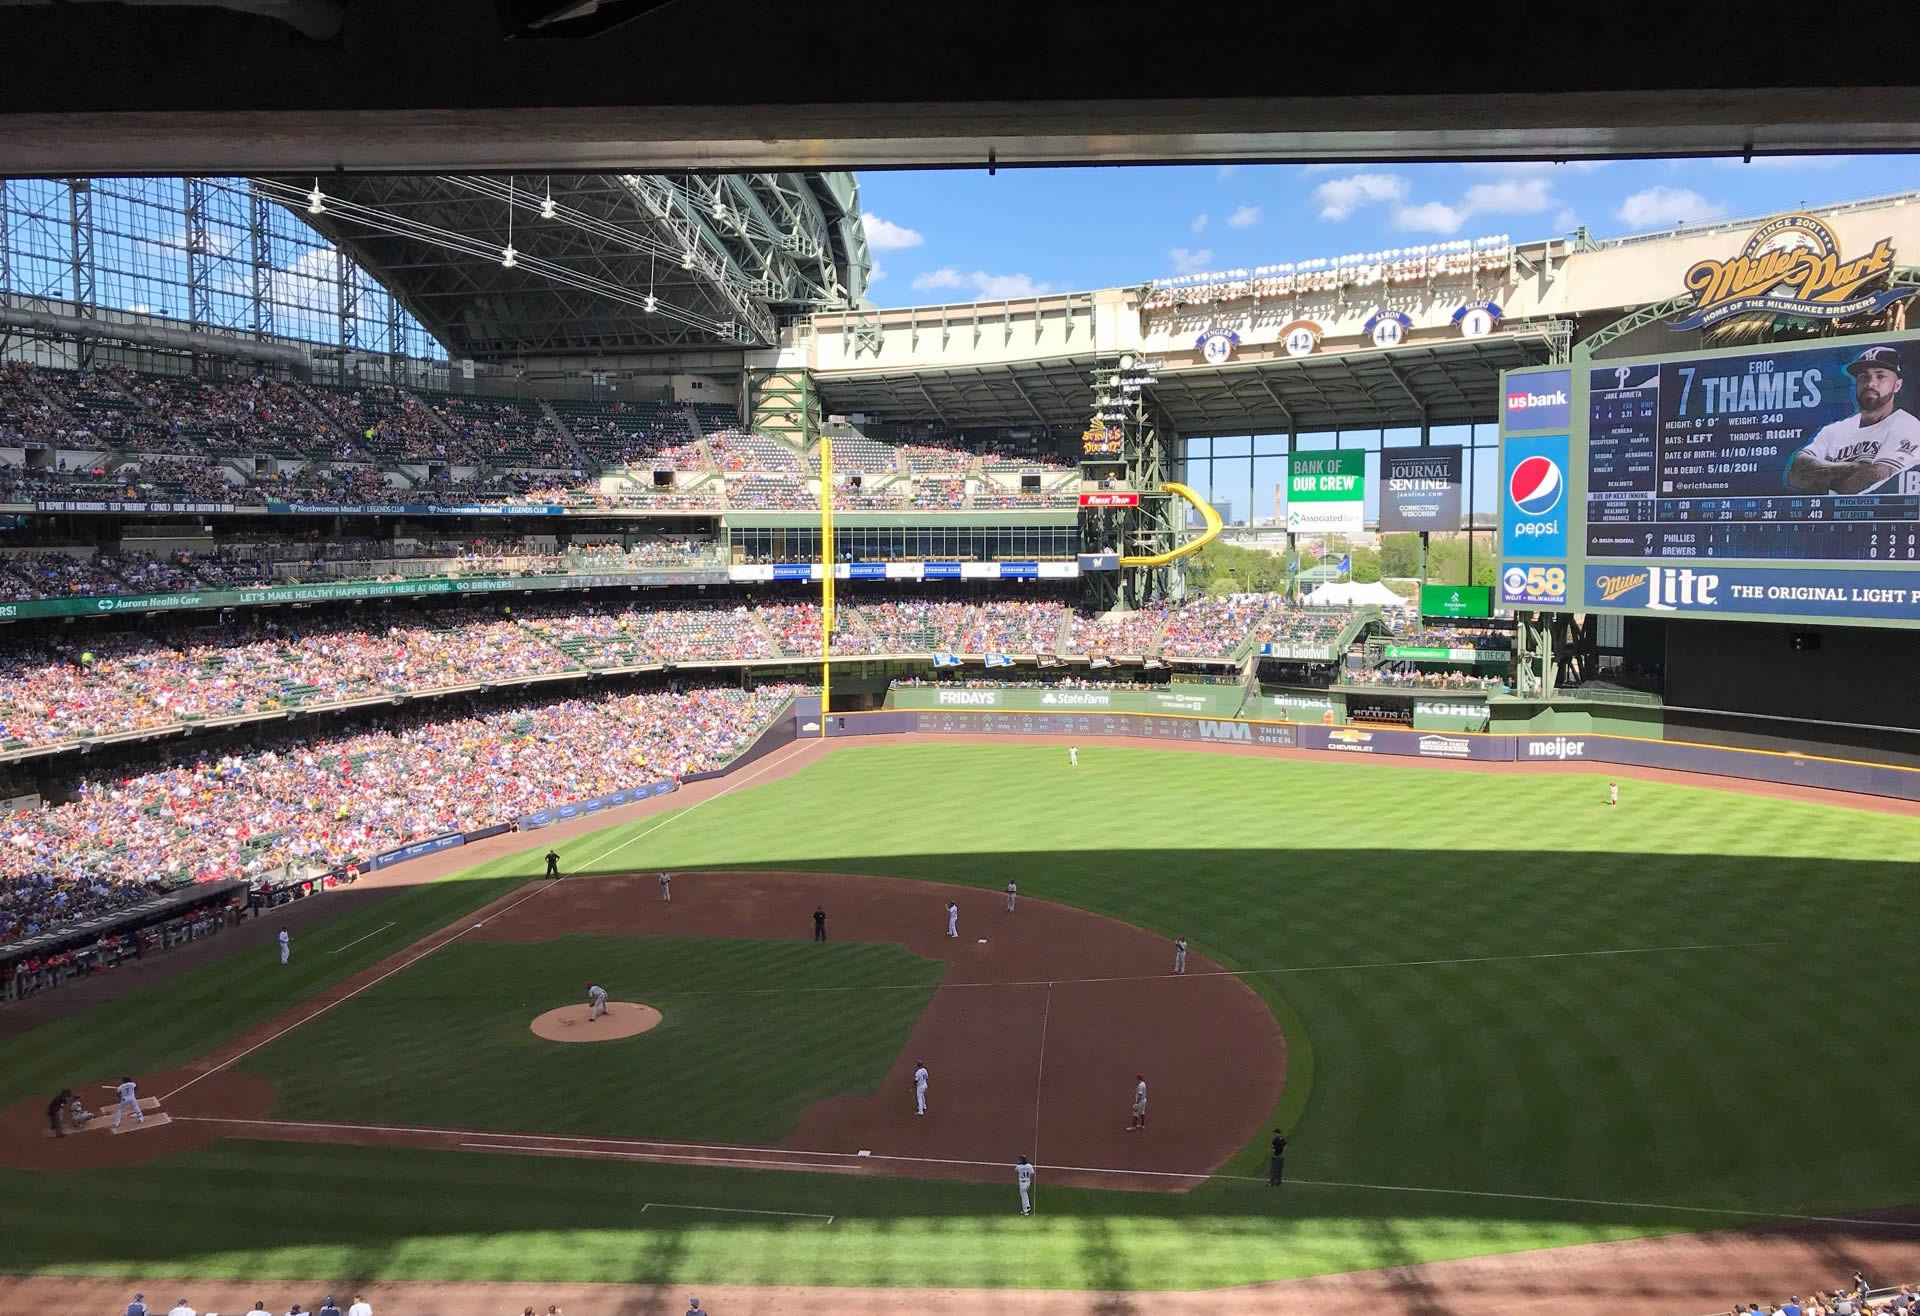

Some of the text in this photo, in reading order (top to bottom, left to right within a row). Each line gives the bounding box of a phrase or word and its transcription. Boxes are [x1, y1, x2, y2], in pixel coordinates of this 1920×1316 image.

[1757, 218, 1821, 241] SINCE 2001
[1688, 237, 1893, 307] Miller Park
[1465, 300, 1490, 310] SELIG
[1703, 296, 1876, 323] HOME OF THE MILWAUKEE BREWERS
[1374, 310, 1401, 322] AARON
[1472, 316, 1482, 335] 1
[1203, 330, 1234, 340] FINGERS
[1376, 324, 1398, 342] 44
[1289, 333, 1310, 349] 42
[1207, 341, 1227, 358] 34
[1749, 360, 1774, 374] ERIC
[1604, 391, 1642, 400] JAKE ARRIETA
[1678, 367, 1696, 416] 7
[1702, 368, 1822, 414] THAMES
[1665, 420, 1693, 429] HEIGHT:
[1728, 416, 1759, 426] WEIGHT:
[1761, 413, 1784, 424] 240
[1665, 428, 1803, 445] BATS: LEFT THROWS: RIGHT
[1664, 446, 1778, 460] DATE OF BIRTH: 11/10/1986
[1294, 460, 1343, 475] BANK OF
[1391, 464, 1452, 480] JOURNAL
[1664, 463, 1758, 475] MLB DEBUT: 5/18/2011
[1293, 475, 1317, 491] OUR
[1389, 478, 1452, 491] SENTINEL
[1676, 481, 1729, 491] @ericthames
[46, 501, 65, 511] REPORT
[110, 502, 122, 512] TEXT
[297, 503, 405, 513] Northwestern Mutual LEGENDS CLUB
[436, 505, 548, 514] Northwestern Mutual LEGENDS CLUB
[1721, 501, 1731, 509] 24
[1767, 500, 1772, 508] 5
[1810, 499, 1821, 507] 20
[1301, 513, 1343, 523] Associated
[1807, 510, 1823, 519] .413
[1515, 520, 1559, 538] pepsi
[1663, 533, 1915, 545] PHILLIES 2 3 0
[1662, 547, 1915, 558] BREWERS 0 0 2 0
[1527, 567, 1566, 597] 58
[1597, 566, 1719, 612] Miller Lite
[239, 592, 265, 602] LET'S
[267, 591, 294, 601] MAKE
[295, 588, 335, 600] HEALTHY
[335, 586, 369, 598] HAPPEN
[369, 584, 393, 596] RIGHT
[394, 584, 415, 594] HERE
[417, 584, 428, 592] AT
[456, 582, 470, 590] GO
[471, 580, 515, 590] BREWERS!
[1731, 584, 1764, 599] THE
[1768, 586, 1847, 601] ORIGINAL
[1852, 588, 1907, 603] LIGHT
[115, 596, 200, 609] Aurora Health Care
[1527, 595, 1565, 603] MILWAUKEE
[1272, 644, 1330, 660] Club Goodwill
[940, 692, 996, 705] FRIDAYS
[1284, 693, 1332, 709] impact
[1198, 720, 1253, 740] WM
[1260, 727, 1290, 735] THINK
[1258, 735, 1294, 744] GREEN.
[1328, 743, 1374, 752] CHEVROLET
[1529, 737, 1586, 760] meijer
